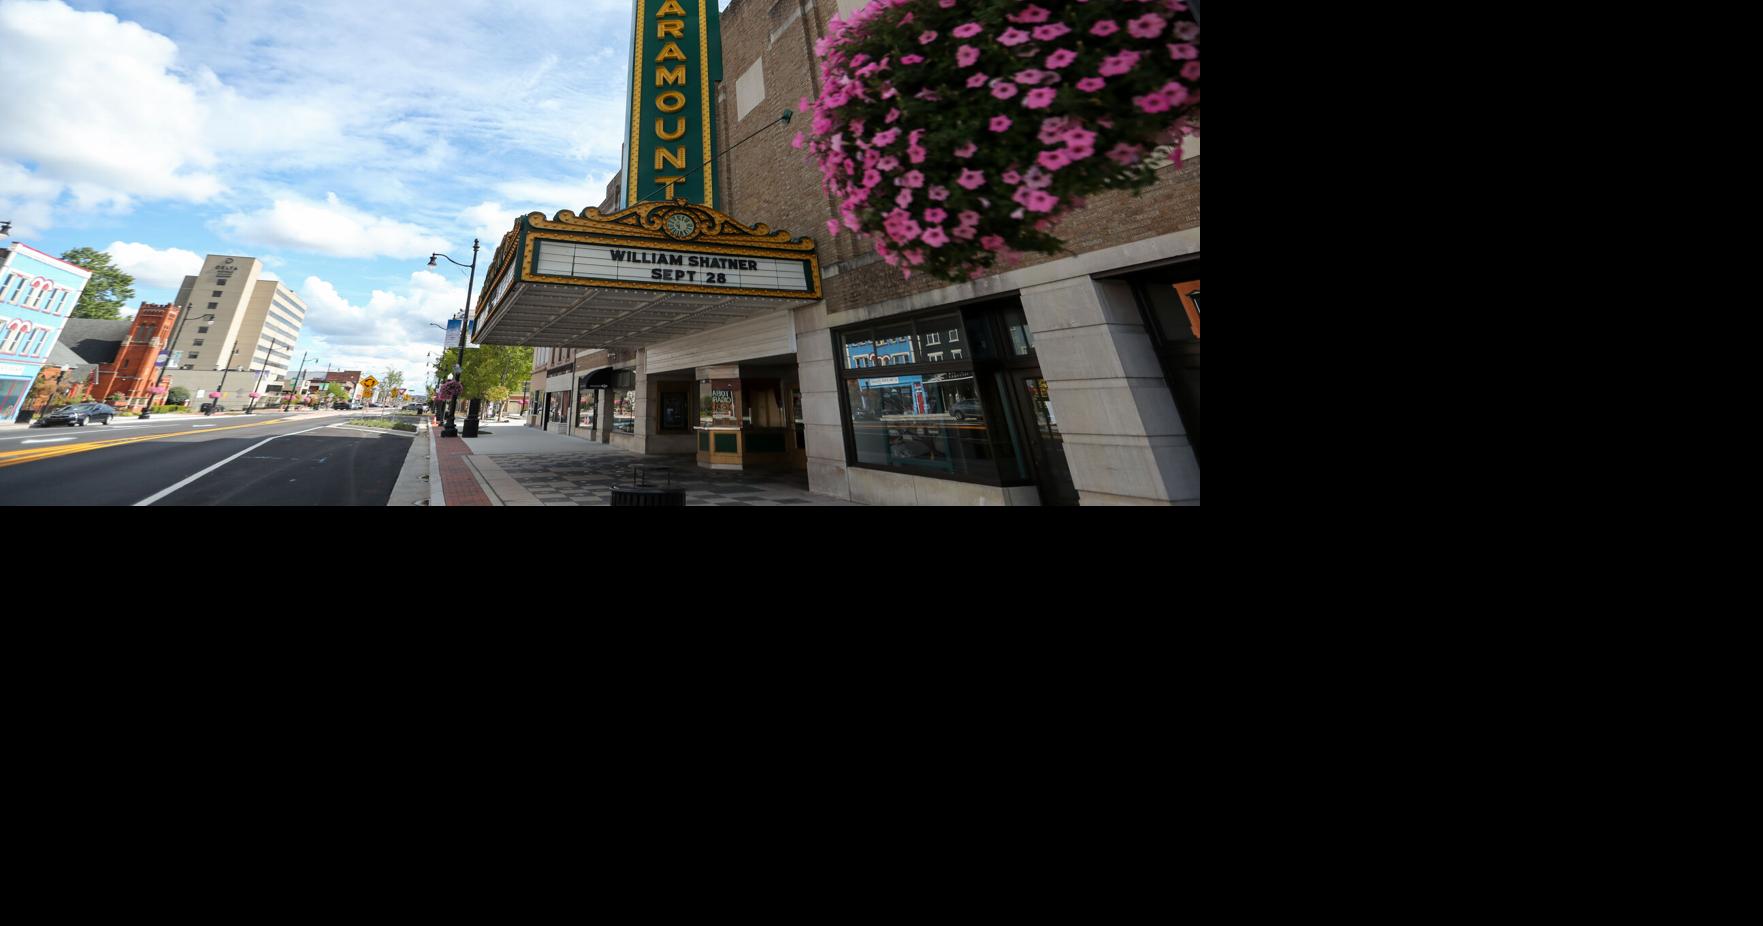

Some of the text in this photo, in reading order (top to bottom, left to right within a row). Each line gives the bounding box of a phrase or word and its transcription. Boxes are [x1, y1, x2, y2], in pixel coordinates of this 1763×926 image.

[610, 249, 758, 270] WILLIAM SHATNER
[651, 268, 727, 284] SEPT 28
